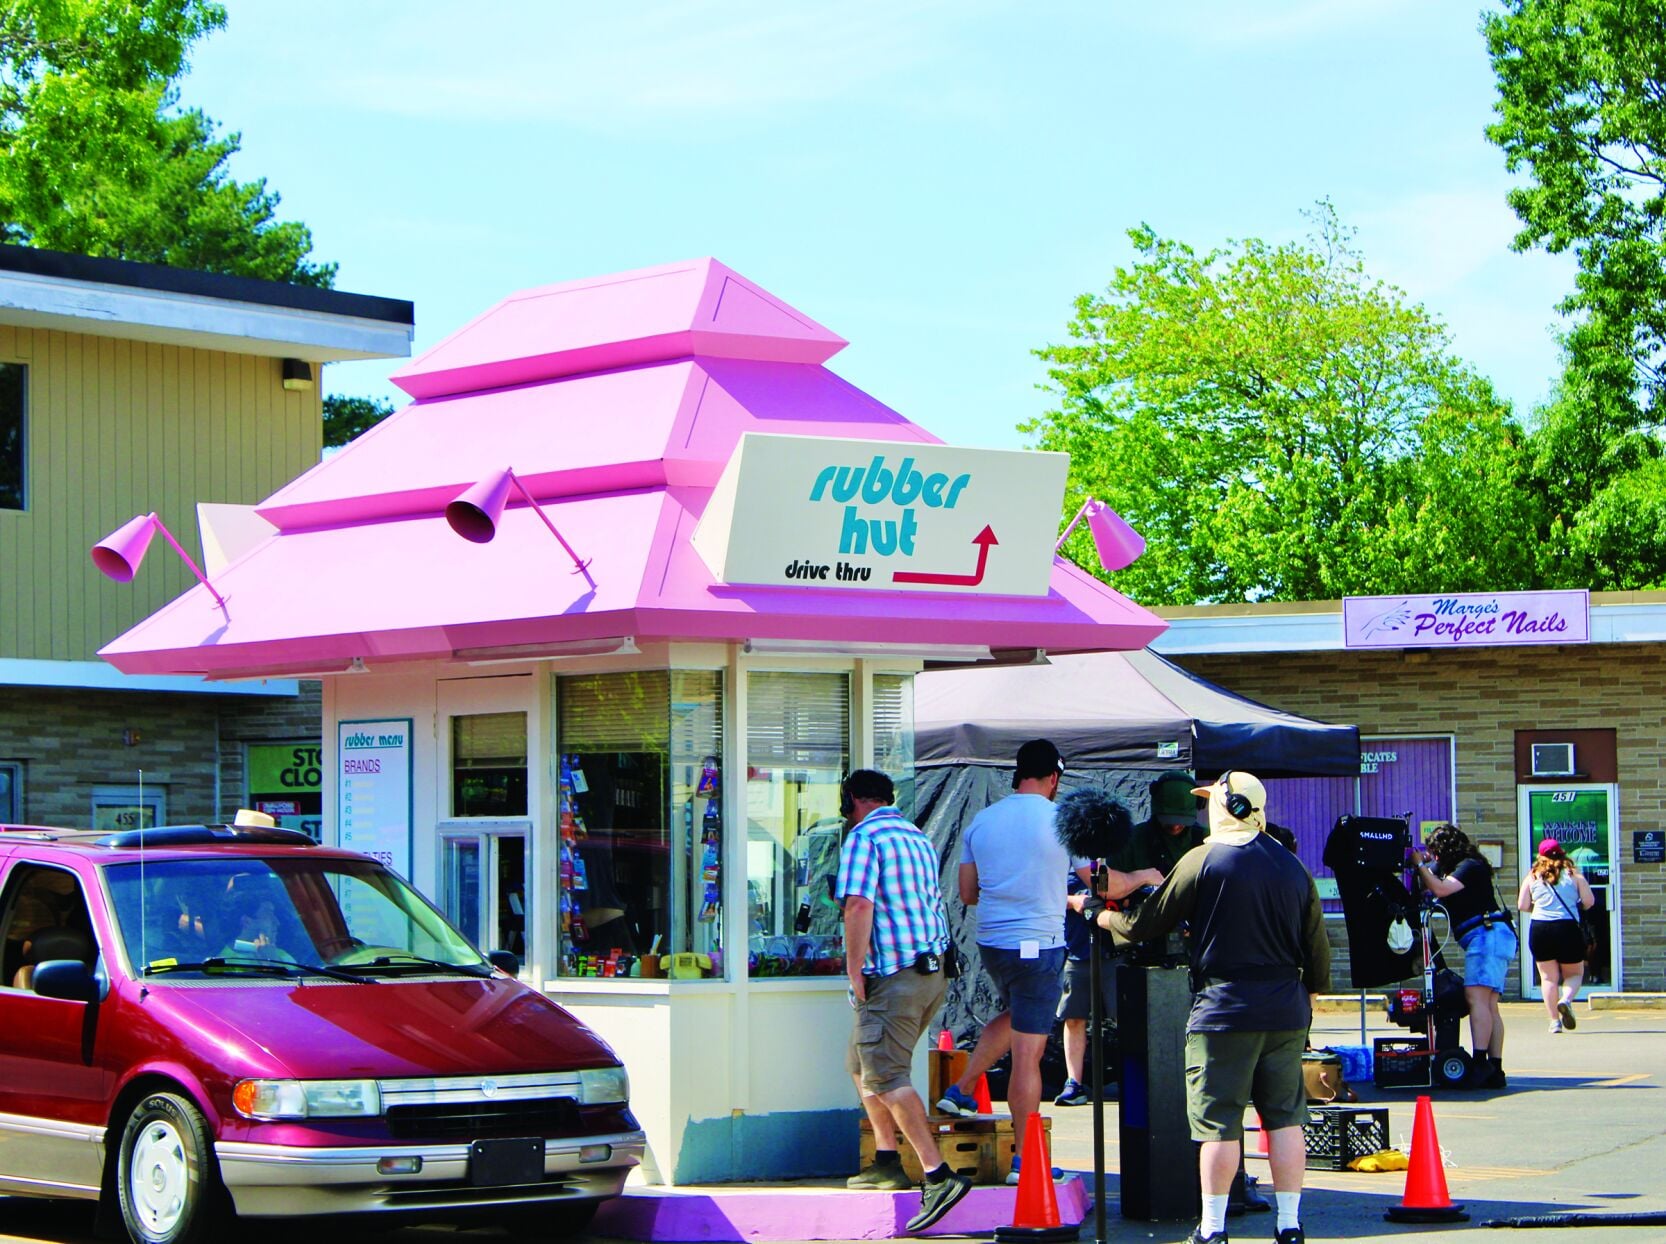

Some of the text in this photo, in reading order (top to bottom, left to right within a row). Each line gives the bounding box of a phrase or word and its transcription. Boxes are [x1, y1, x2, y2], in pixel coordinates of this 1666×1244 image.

[809, 455, 971, 509] rubber
[838, 505, 918, 557] hut
[784, 560, 872, 582] drive thru
[1432, 599, 1500, 619] Marge's
[1414, 610, 1569, 642] Perfect Nails
[344, 732, 403, 748] rubber menu
[344, 759, 381, 773] BRANDS
[1360, 831, 1393, 840] SMALLHD
